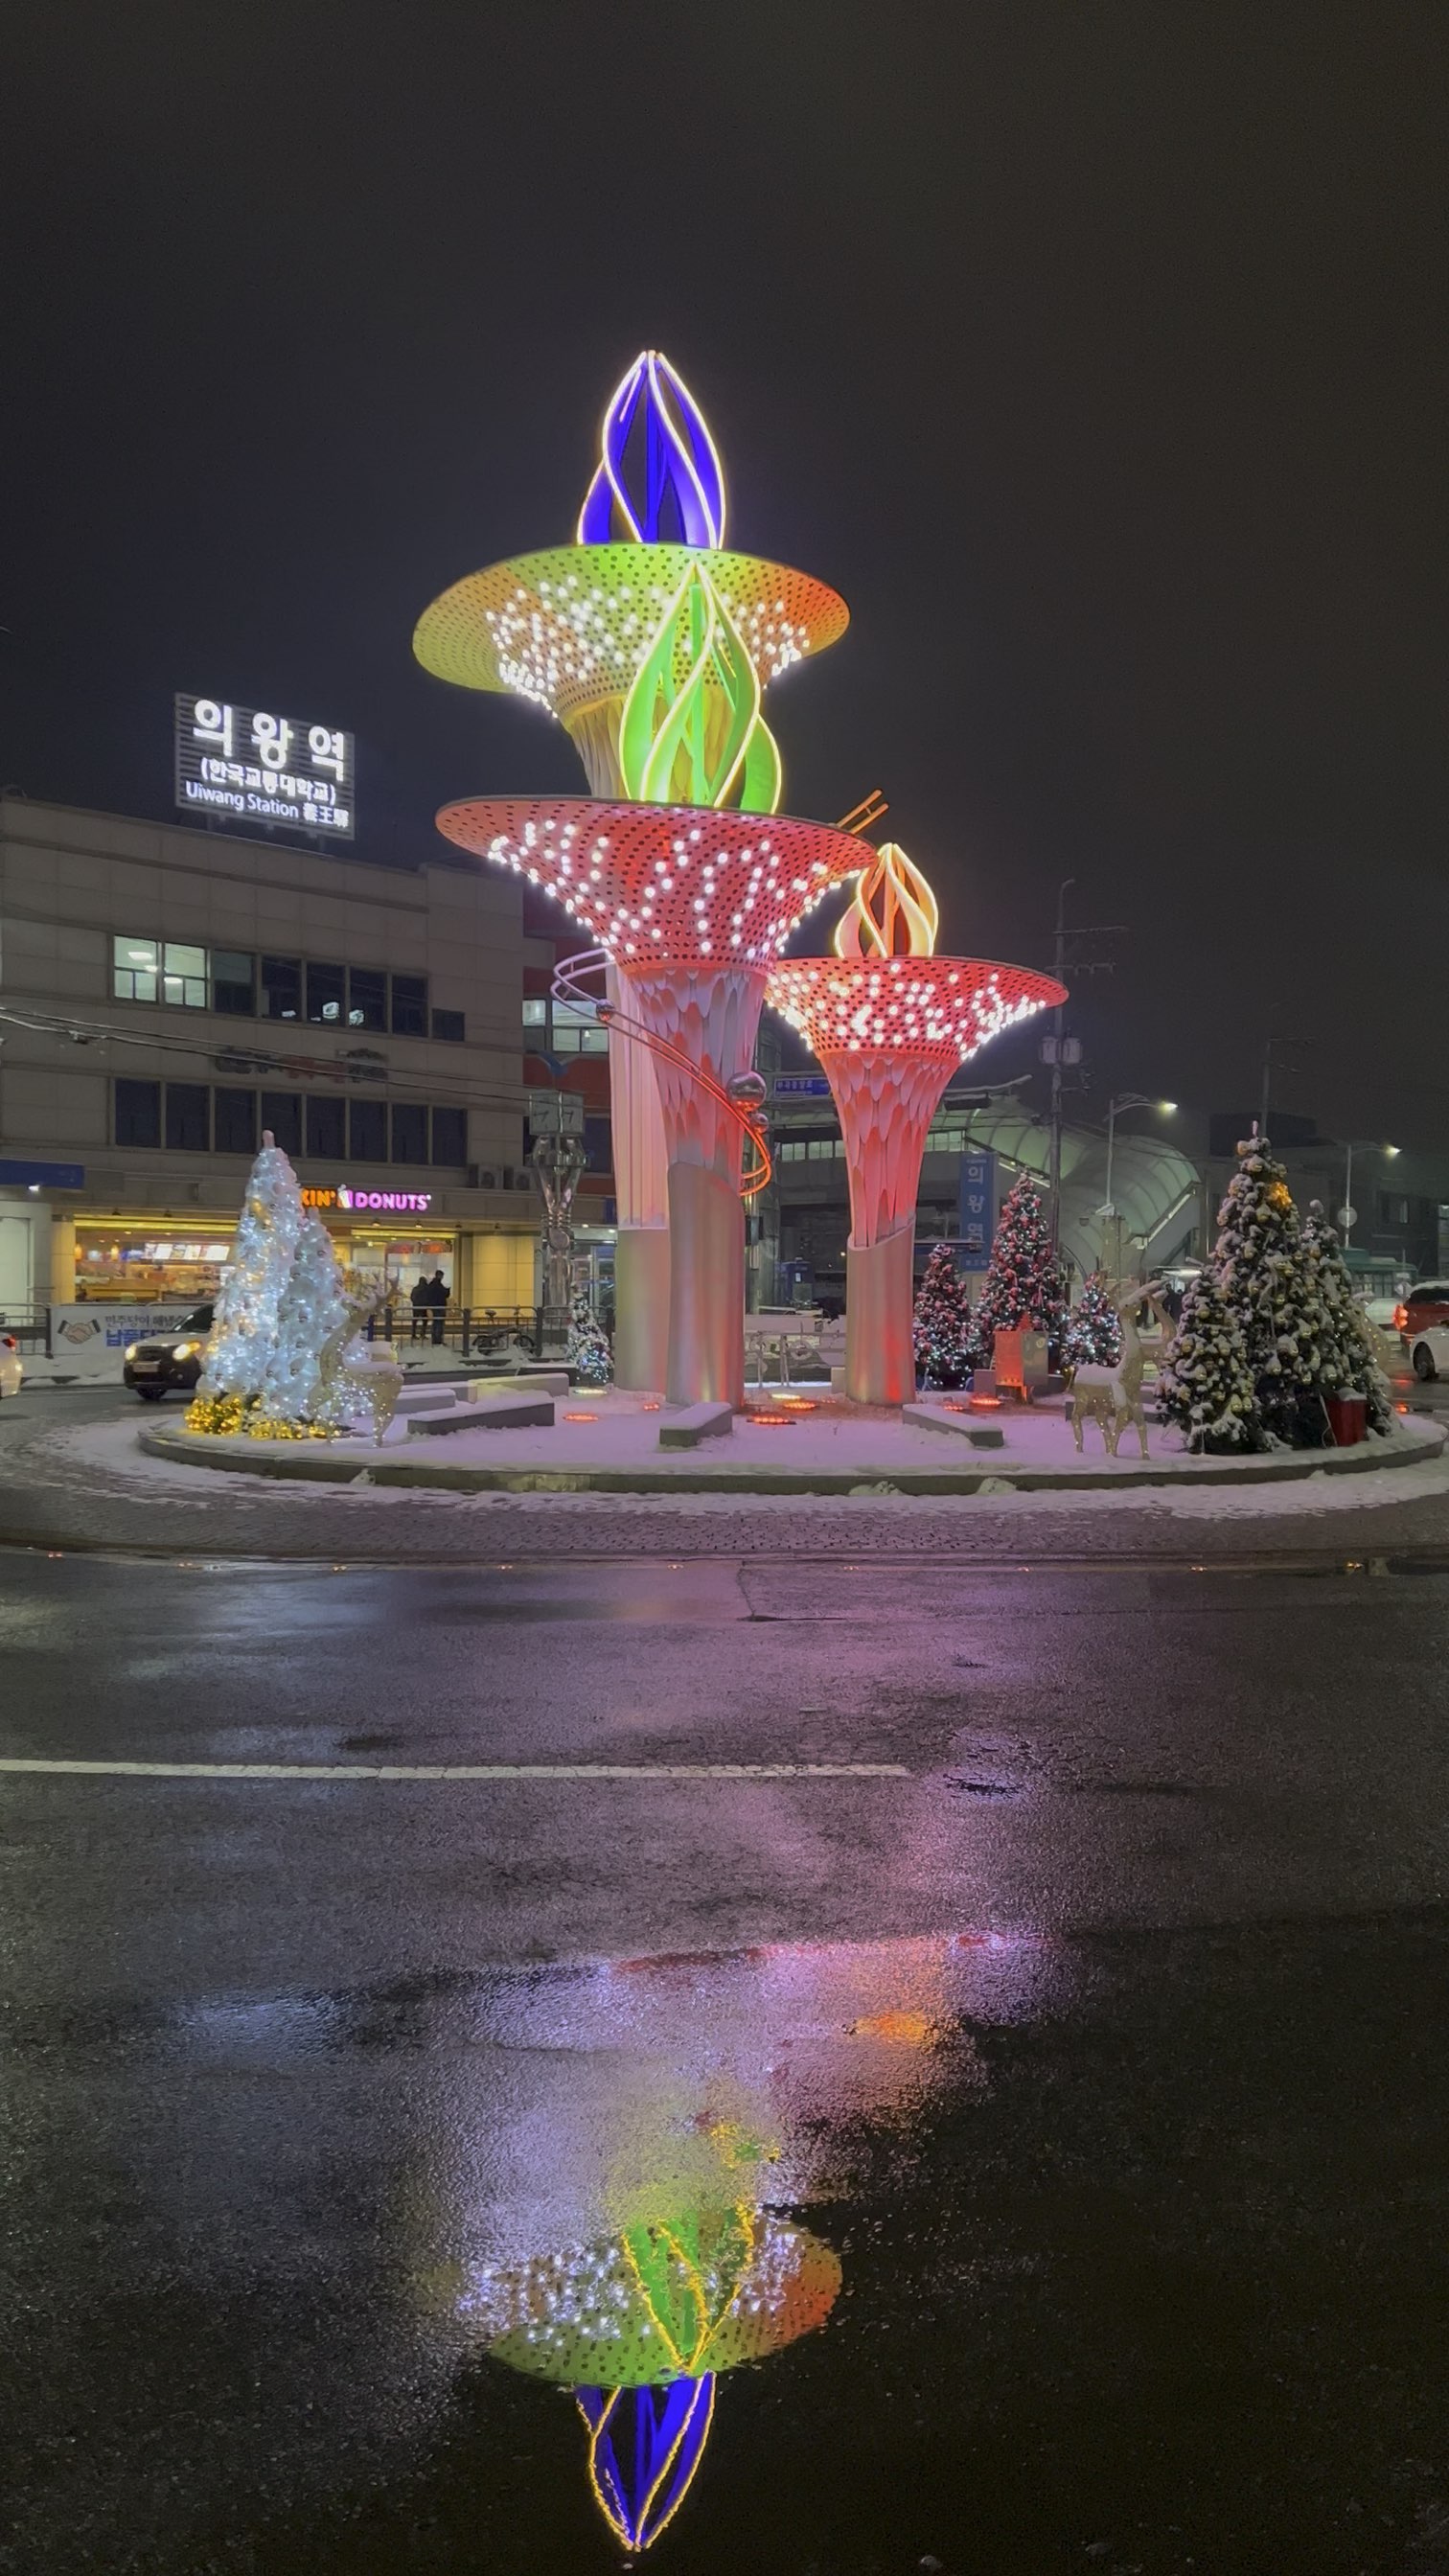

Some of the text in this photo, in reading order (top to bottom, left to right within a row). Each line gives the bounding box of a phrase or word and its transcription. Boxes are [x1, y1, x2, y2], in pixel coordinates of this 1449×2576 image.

[185, 780, 299, 817] Uiwang Station
[355, 1192, 427, 1210] DONUTS
